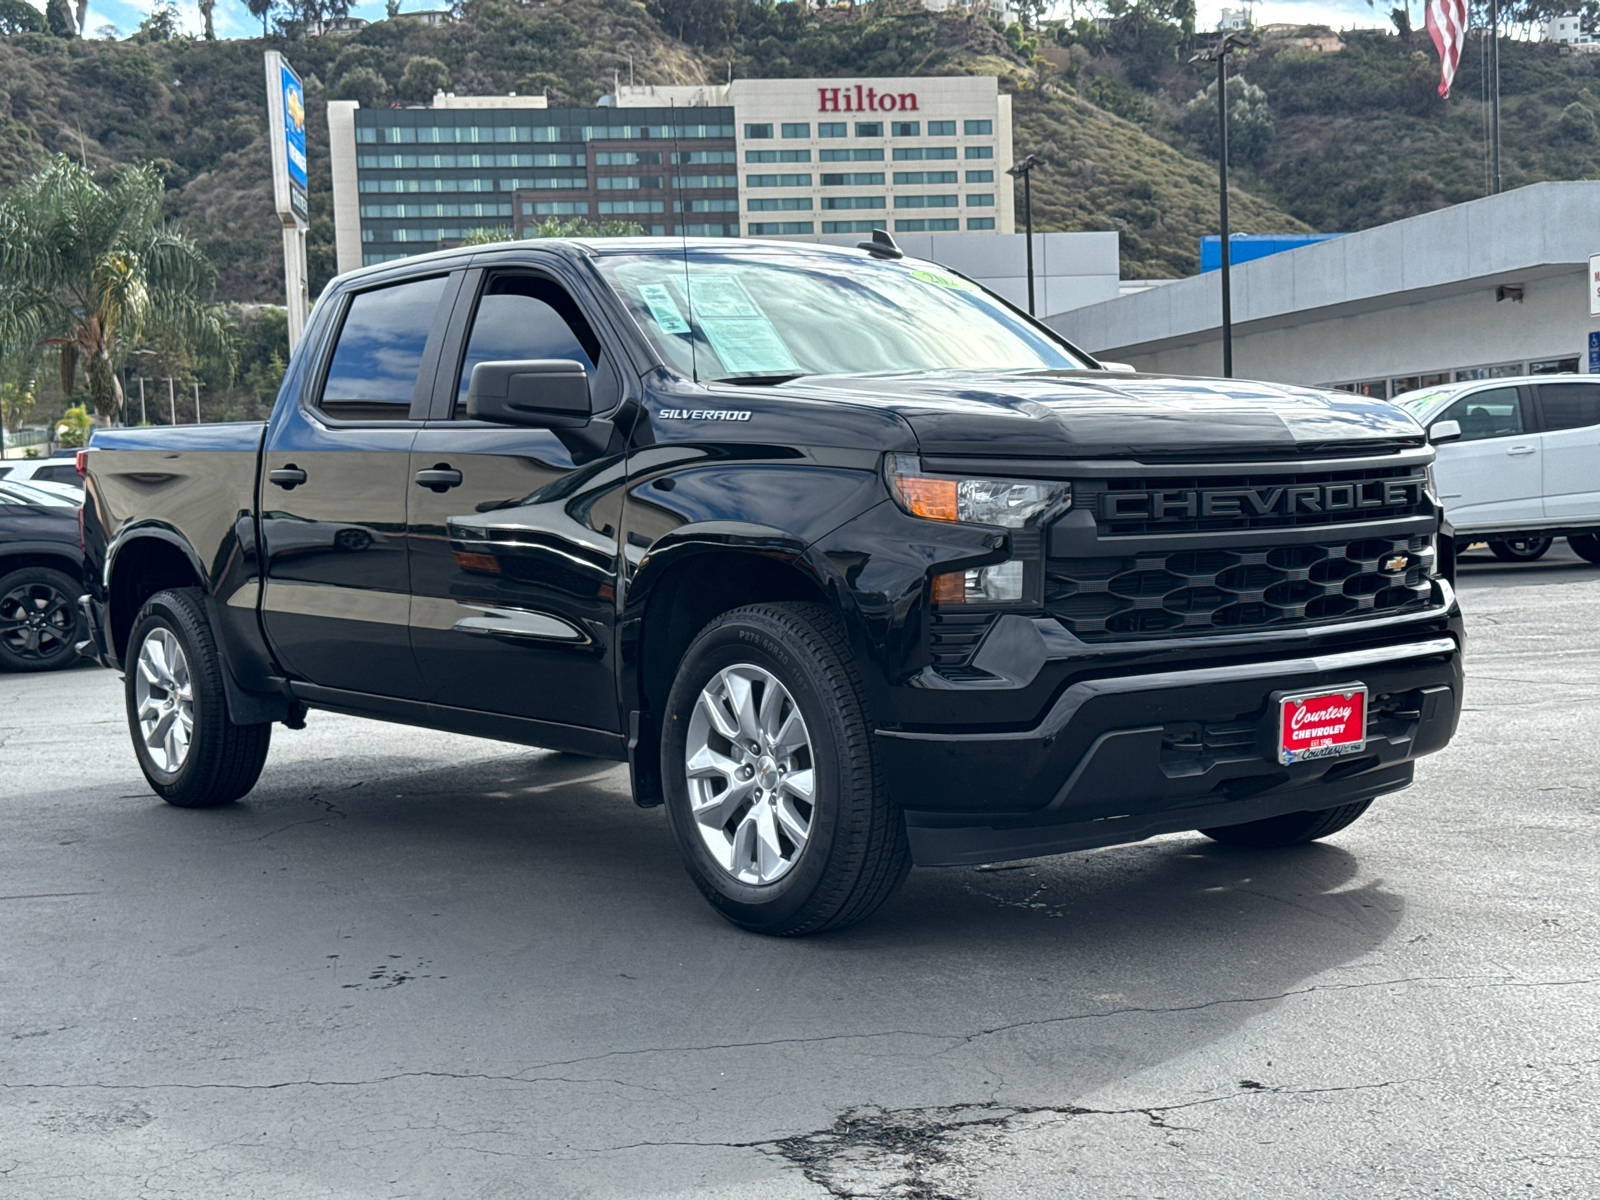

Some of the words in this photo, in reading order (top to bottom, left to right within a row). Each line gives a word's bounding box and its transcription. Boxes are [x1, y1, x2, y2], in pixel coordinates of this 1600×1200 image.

[817, 84, 920, 112] Hilton
[658, 408, 753, 422] SILVERADO
[1102, 478, 1428, 520] CHEVROLET
[738, 630, 789, 666] P275/60R20
[1291, 705, 1352, 730] Courtesy
[1292, 724, 1346, 741] CHEVROLET
[1302, 745, 1344, 760] Courtesy
